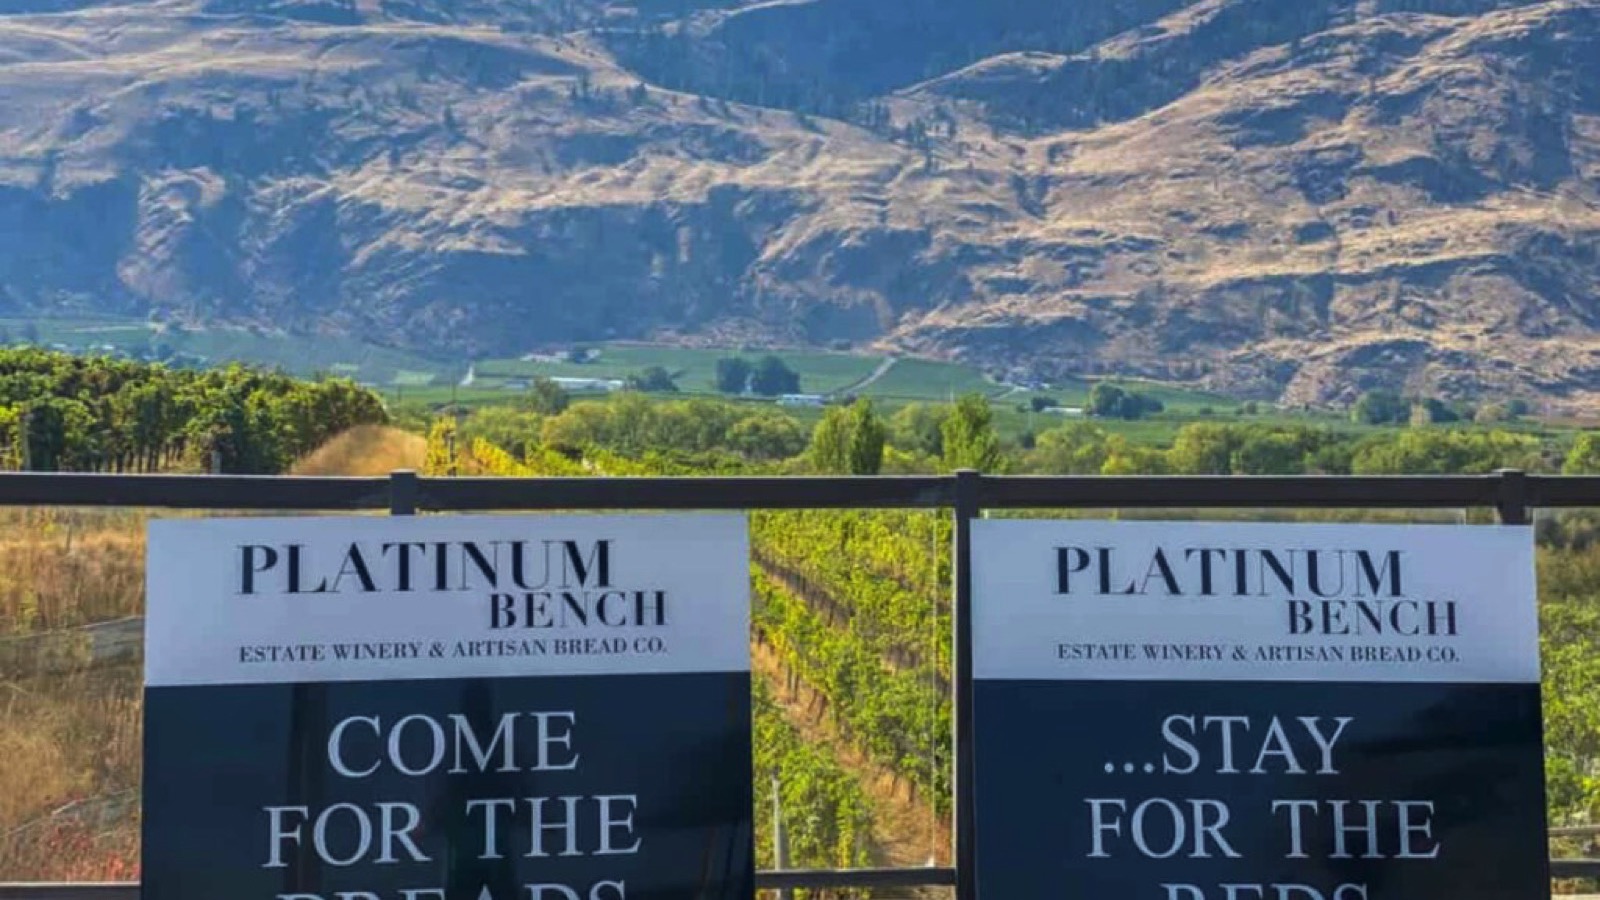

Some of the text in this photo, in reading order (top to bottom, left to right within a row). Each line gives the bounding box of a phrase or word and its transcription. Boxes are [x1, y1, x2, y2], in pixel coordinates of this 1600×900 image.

[237, 539, 613, 594] PLATINUM
[1053, 546, 1405, 598] PLATINUM
[489, 590, 667, 630] BENCH
[1287, 600, 1459, 636] BENCH
[239, 637, 668, 663] ESTATE WINERY & ARTISAN BREAD CO.
[1057, 643, 1460, 662] ESTATE WINERY & ARTISAN BREAD CO.
[327, 711, 580, 778] COME
[1103, 714, 1354, 776] ...STAY
[261, 793, 643, 869] FOR THE
[1085, 797, 1441, 859] FOR THE
